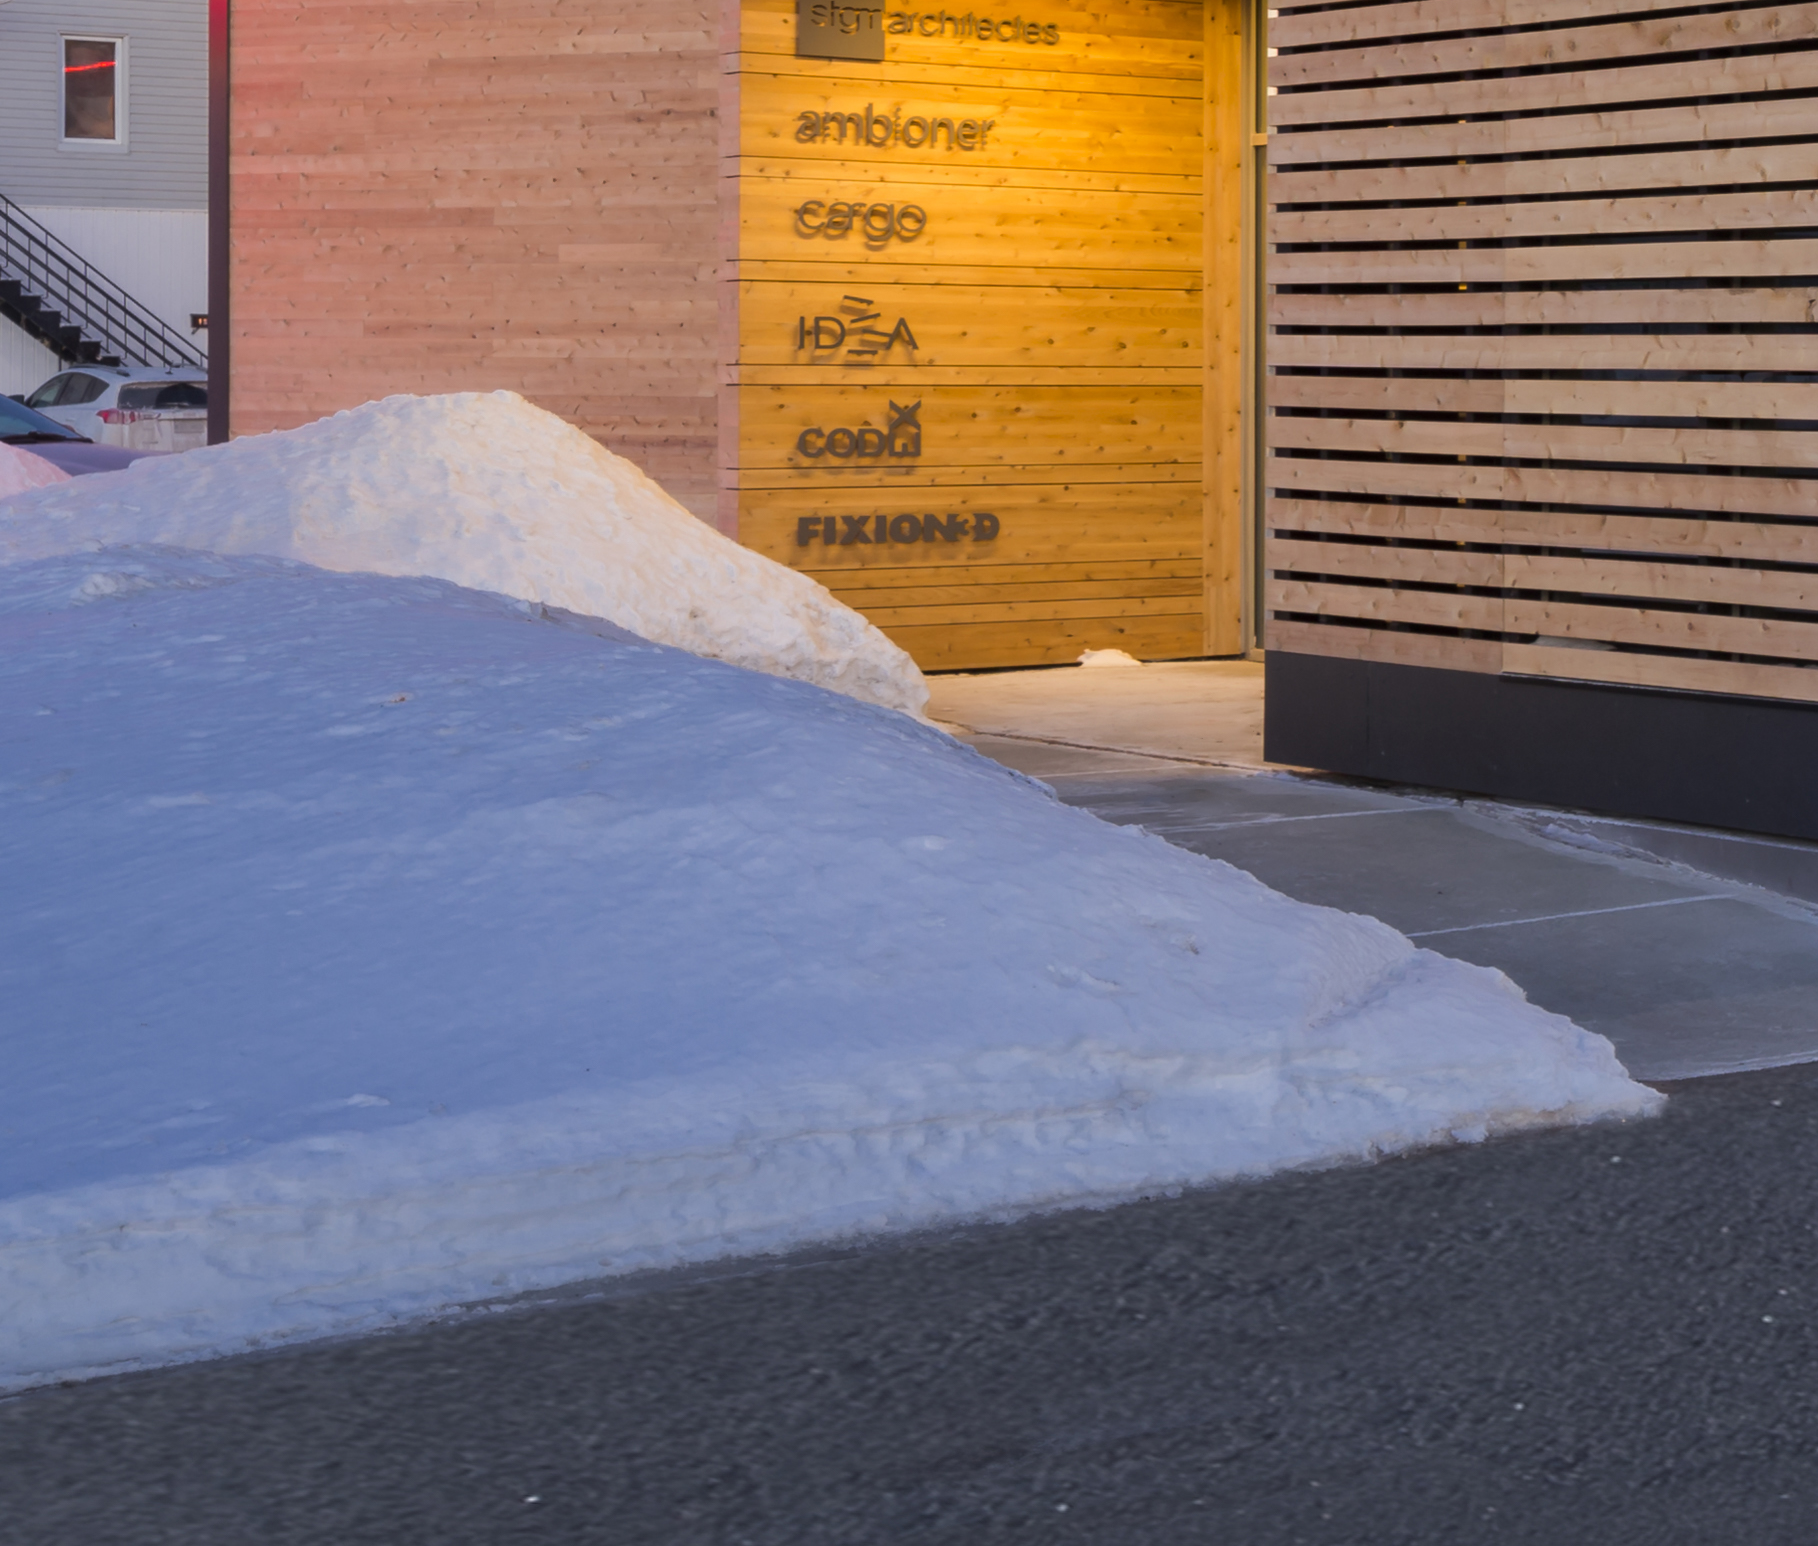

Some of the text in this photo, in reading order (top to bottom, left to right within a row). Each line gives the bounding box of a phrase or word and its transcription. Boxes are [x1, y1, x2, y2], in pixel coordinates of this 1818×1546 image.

[888, 9, 1061, 45] architectes
[797, 103, 995, 148] ambioner
[799, 200, 927, 242] cargo
